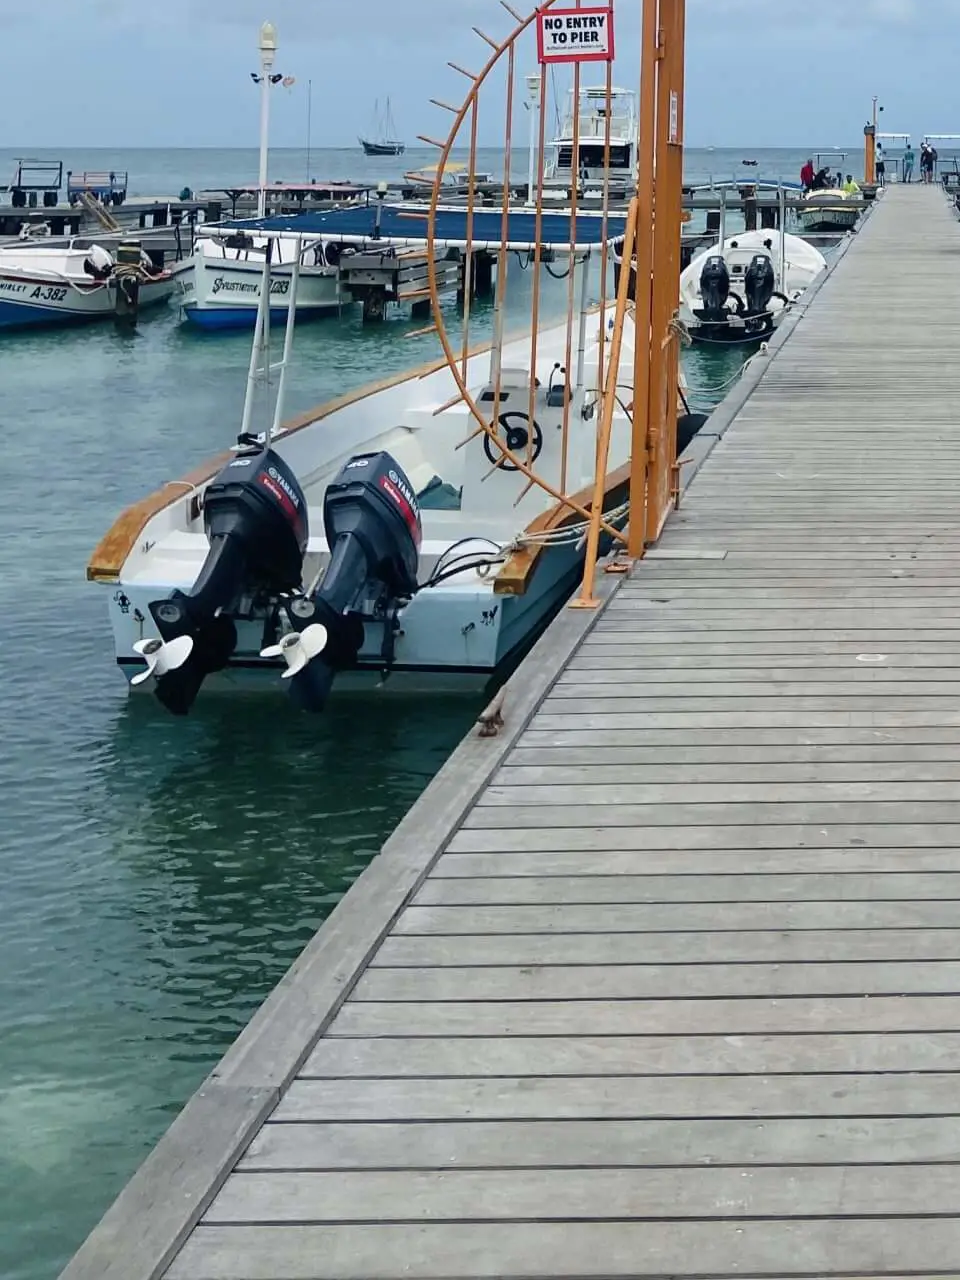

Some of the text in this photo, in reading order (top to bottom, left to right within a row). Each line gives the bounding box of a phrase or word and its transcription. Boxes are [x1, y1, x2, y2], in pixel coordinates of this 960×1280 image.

[544, 16, 605, 30] NO ENTRY
[551, 31, 599, 44] TO PIER
[29, 285, 68, 301] A-382
[276, 473, 300, 509] YAMAHA
